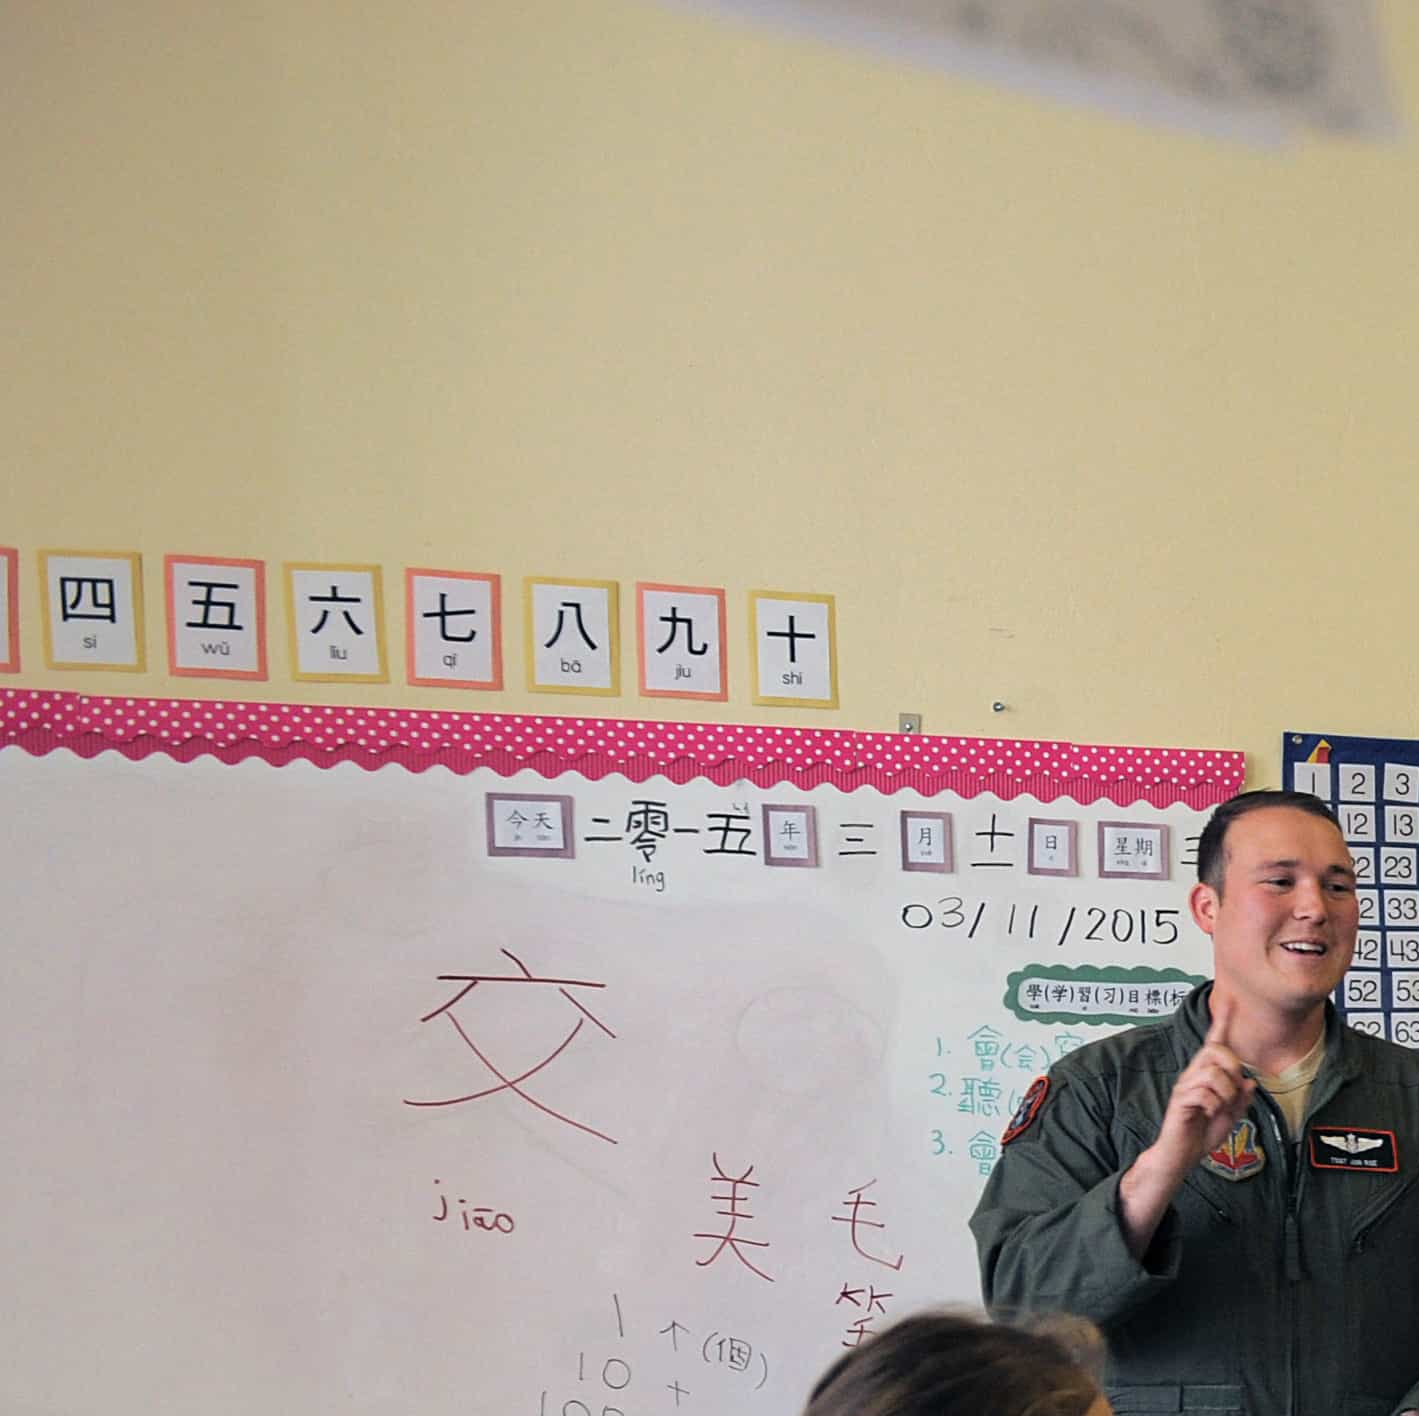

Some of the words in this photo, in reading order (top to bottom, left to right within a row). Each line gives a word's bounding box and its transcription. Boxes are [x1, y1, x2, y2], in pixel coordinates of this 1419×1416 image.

[59, 575, 118, 625] 四
[185, 580, 245, 633] 五
[308, 584, 364, 637] 六
[422, 592, 478, 644] 七
[544, 601, 599, 652] 八
[655, 605, 709, 658] 九
[766, 613, 817, 664] 十
[1311, 772, 1316, 794] 1
[1351, 772, 1366, 795] 2
[1394, 772, 1410, 796] 3
[505, 809, 553, 831] 今天
[779, 819, 801, 840] 年
[838, 823, 878, 856] 三
[918, 827, 932, 847] 月
[1045, 833, 1057, 851] 日
[1113, 836, 1153, 857] 星期
[1346, 812, 1369, 835] 12
[1393, 813, 1414, 837] 13
[1383, 855, 1413, 879] 23
[1387, 897, 1418, 921] 33
[1347, 979, 1378, 1003] 52
[403, 947, 619, 1145] 交
[693, 1151, 776, 1284] 美
[578, 1351, 631, 1390] 10
